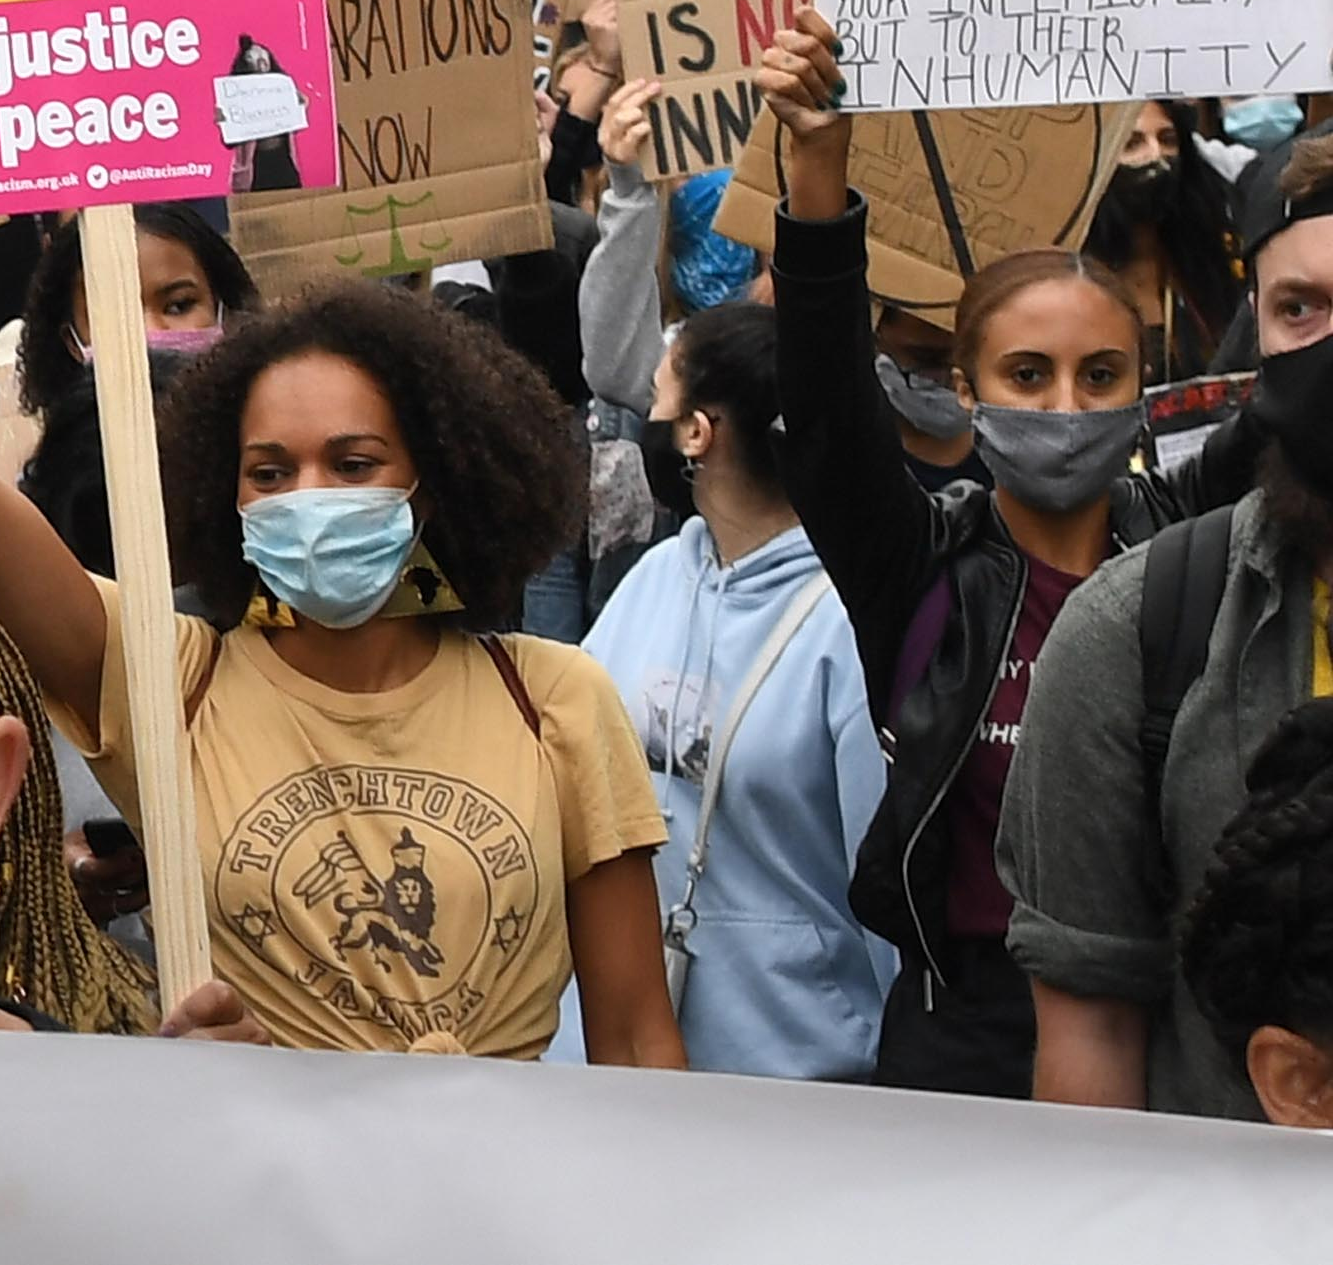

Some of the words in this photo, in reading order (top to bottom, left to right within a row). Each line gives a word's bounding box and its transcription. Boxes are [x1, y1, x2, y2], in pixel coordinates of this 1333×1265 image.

[646, 3, 715, 74] IS
[836, 20, 905, 60] BUT
[931, 15, 977, 56] TO
[1013, 13, 1125, 53] THEIR
[836, 42, 1306, 109] INHUMANITY
[337, 107, 432, 191] NOW
[649, 79, 762, 175] INN
[109, 163, 212, 185] @AntiRacismDay
[231, 771, 527, 881] TRENCHTOWN
